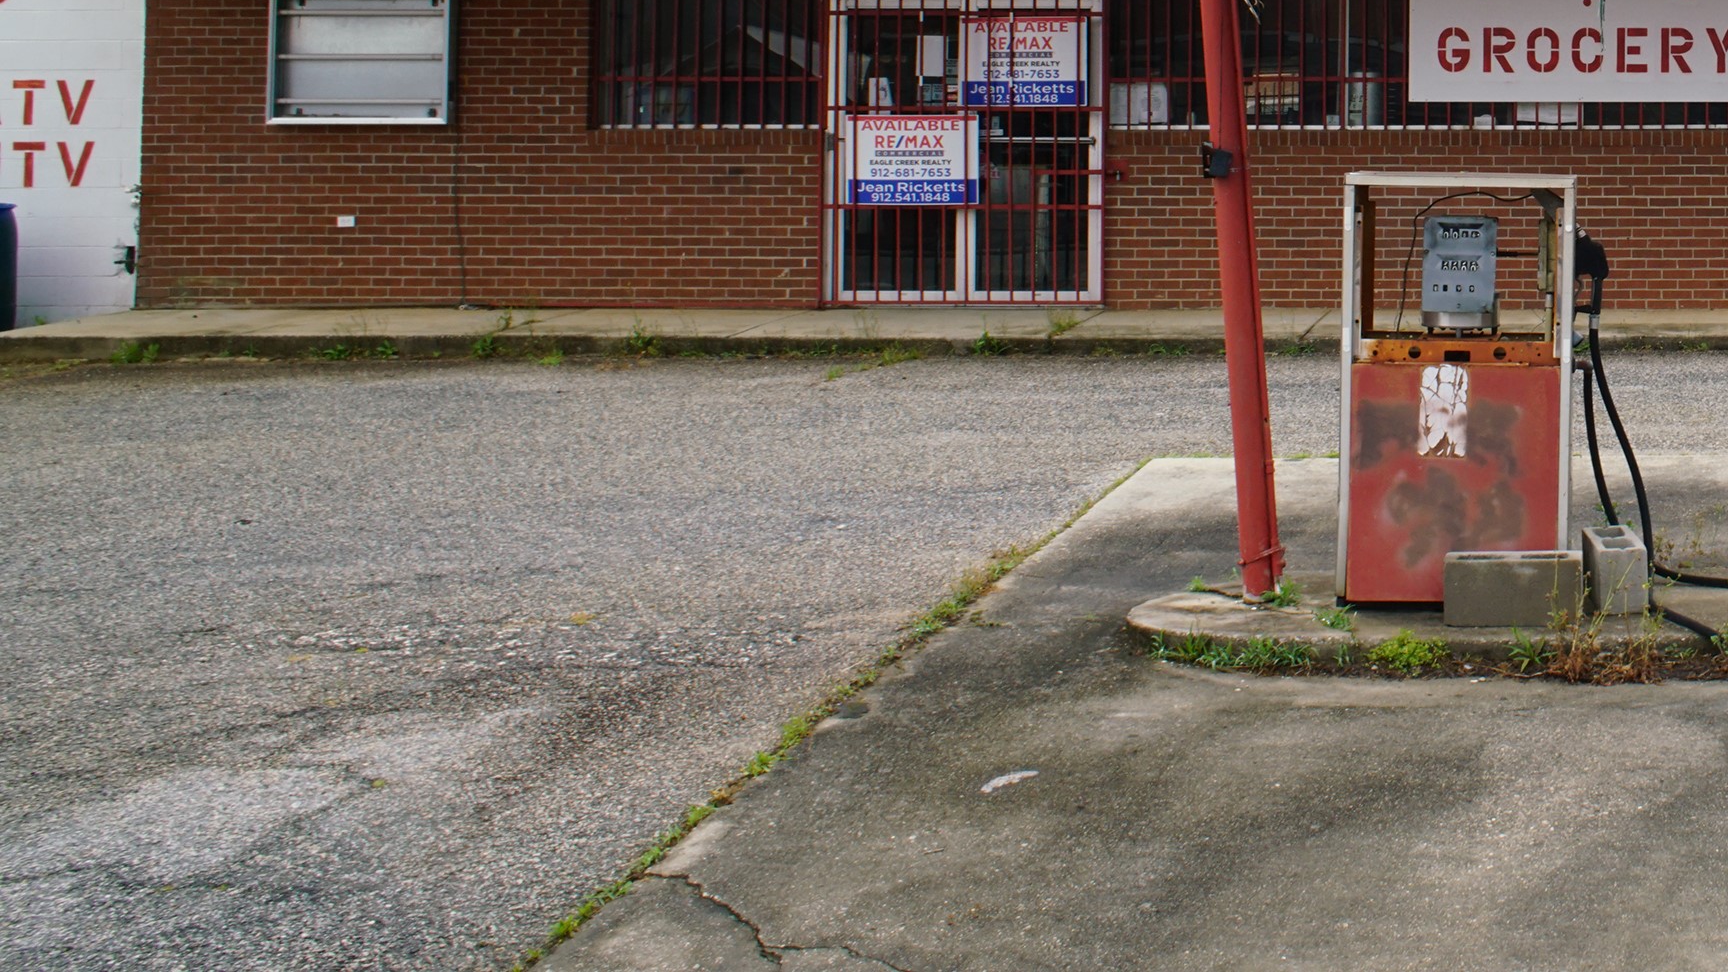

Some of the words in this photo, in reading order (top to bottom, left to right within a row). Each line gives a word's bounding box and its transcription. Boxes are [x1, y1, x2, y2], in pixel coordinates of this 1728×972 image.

[974, 21, 1069, 33] AVALABLE
[983, 69, 1060, 79] 912-681-7653
[0, 79, 95, 126] TV
[861, 120, 960, 131] AVAILABLE
[875, 135, 944, 149] RE/MAX
[0, 141, 95, 188] TV
[870, 168, 951, 177] 912-681-7653
[857, 182, 894, 192] Jean
[898, 182, 966, 192] Ricketts
[871, 193, 950, 202] 912.541.1848
